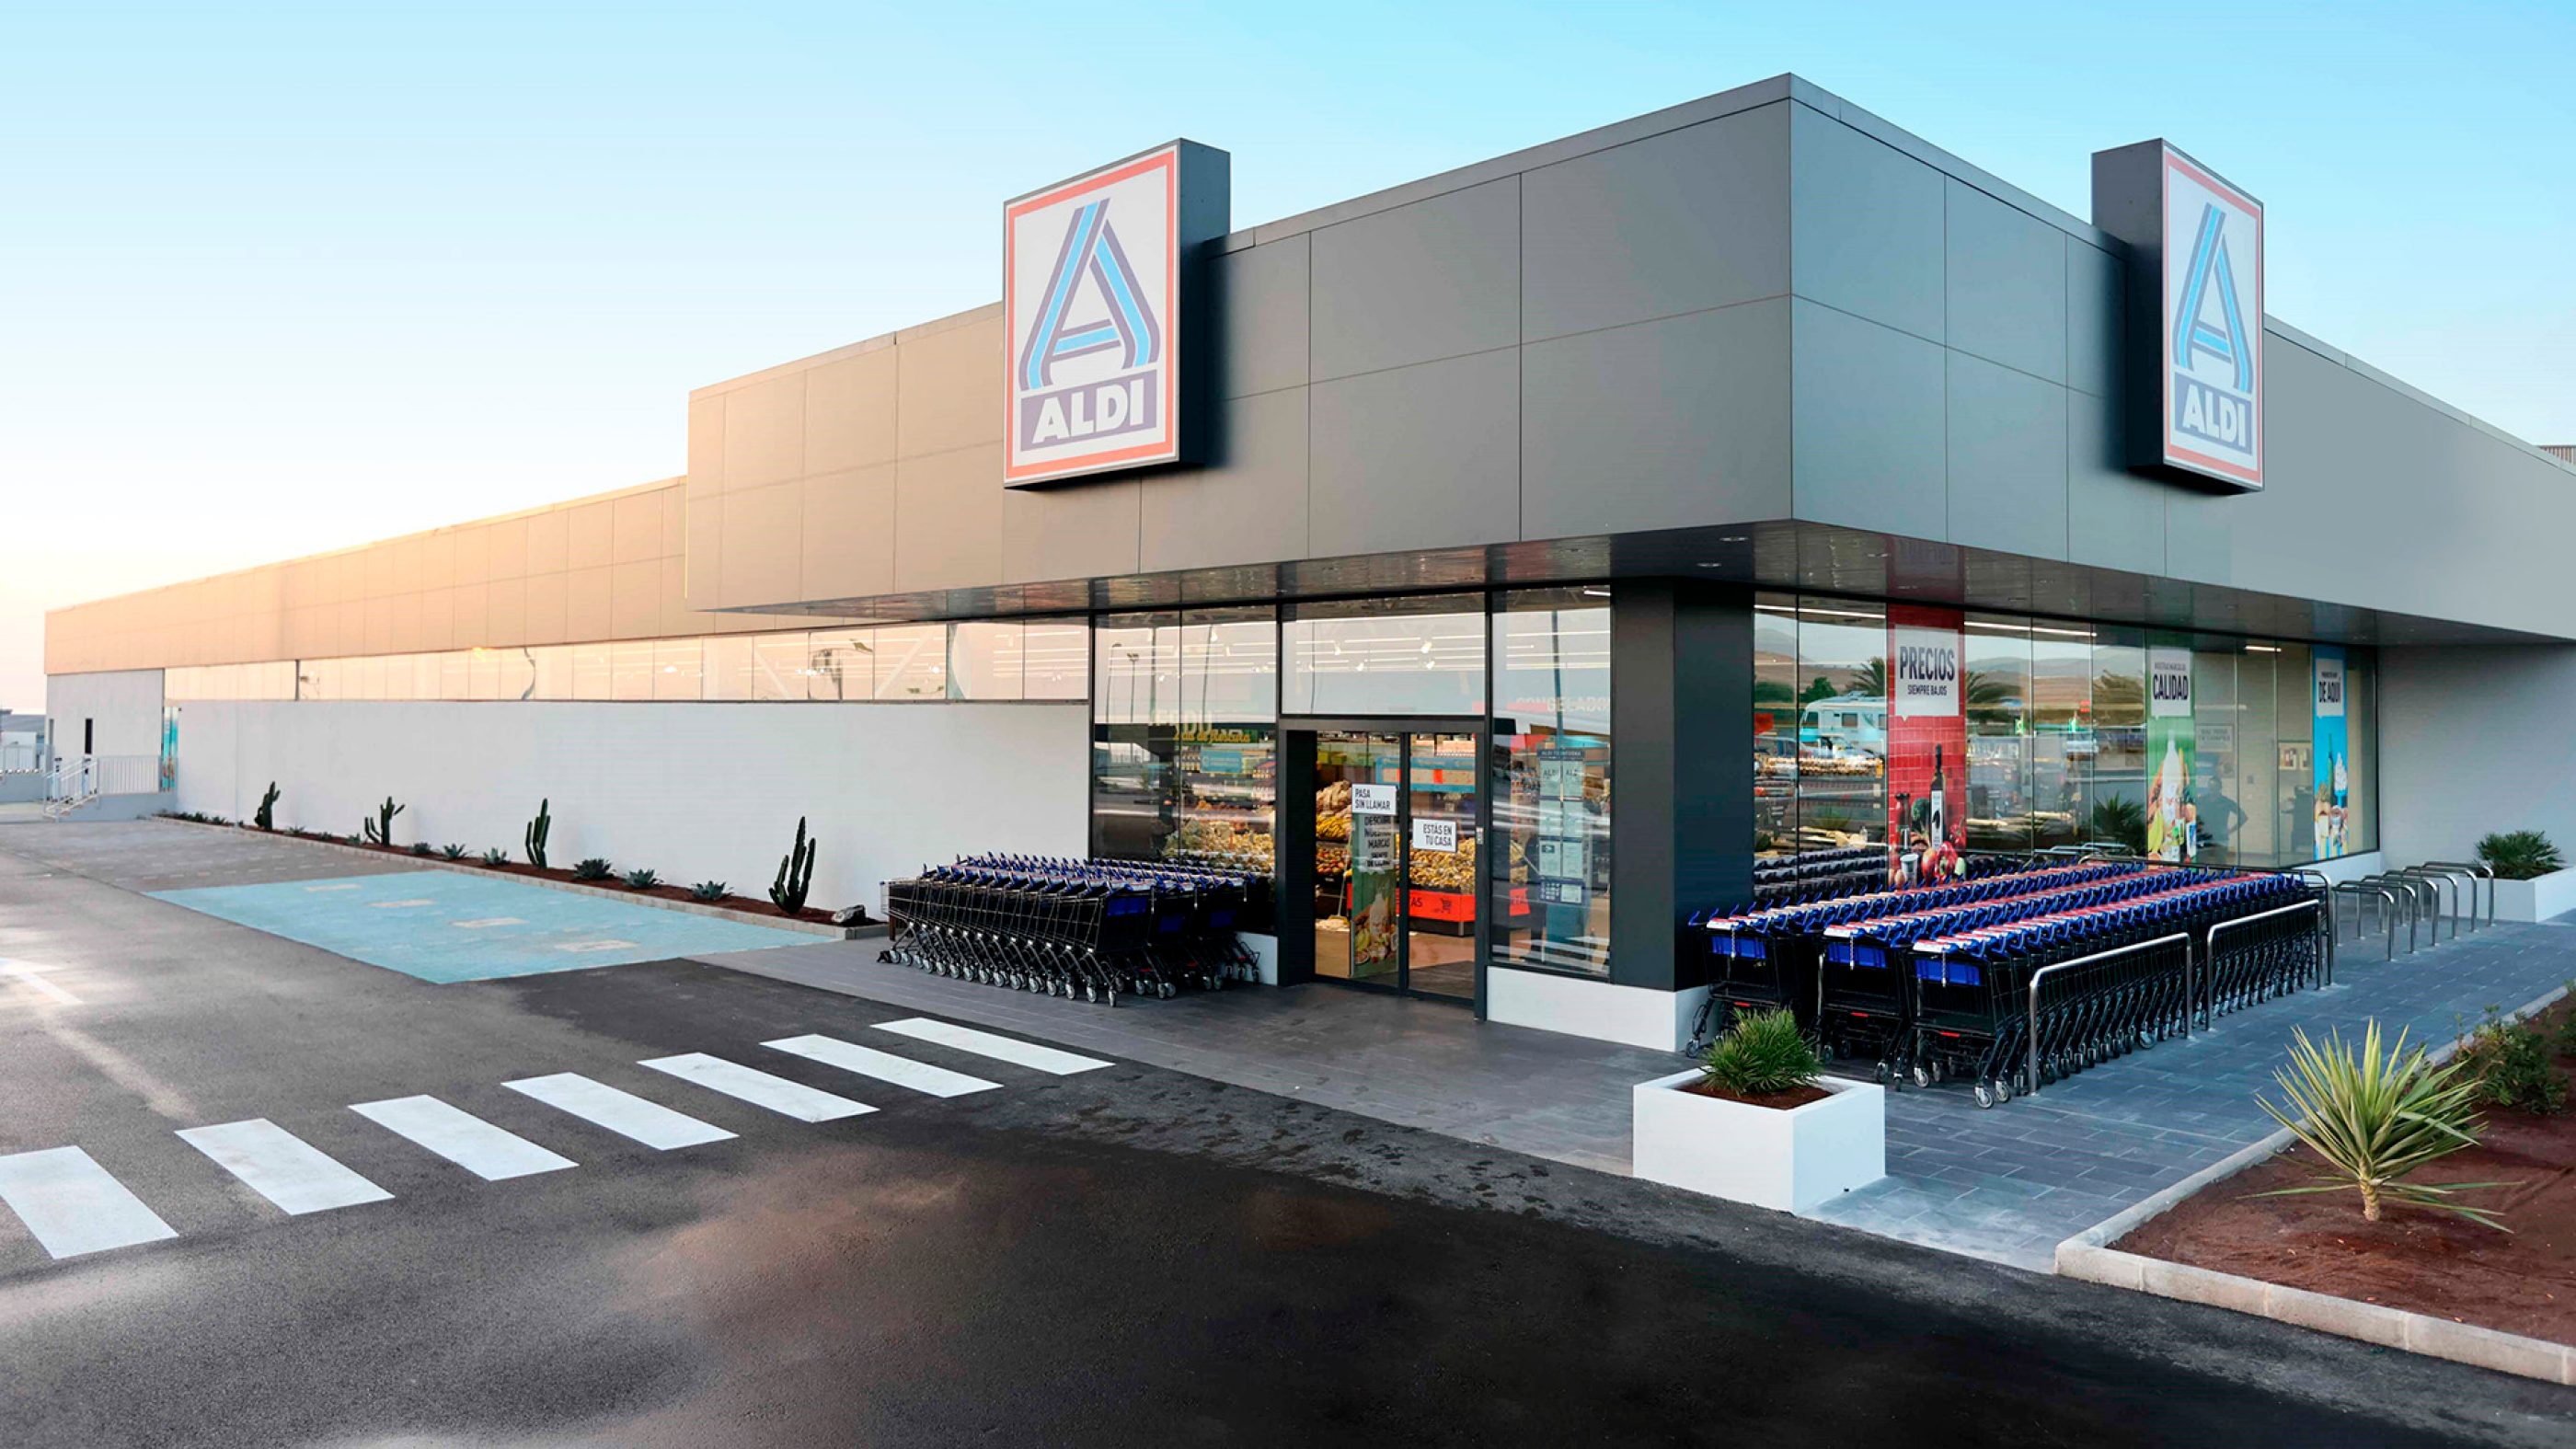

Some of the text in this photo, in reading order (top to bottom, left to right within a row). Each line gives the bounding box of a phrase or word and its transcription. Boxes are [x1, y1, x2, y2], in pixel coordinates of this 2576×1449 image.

[1031, 378, 1144, 444] ALDI
[2181, 384, 2246, 447] ALDI
[1899, 646, 1955, 682] PRECIOS
[1907, 684, 1948, 696] SIEMPRE BAJOS
[2153, 673, 2189, 700] CALIDAD
[2318, 681, 2327, 703] DE
[1354, 788, 1371, 798] PASA
[1354, 799, 1390, 811] SIN LLAMAR
[1423, 822, 1453, 835] ESTÁS EN
[1426, 835, 1453, 846] TU CASA
